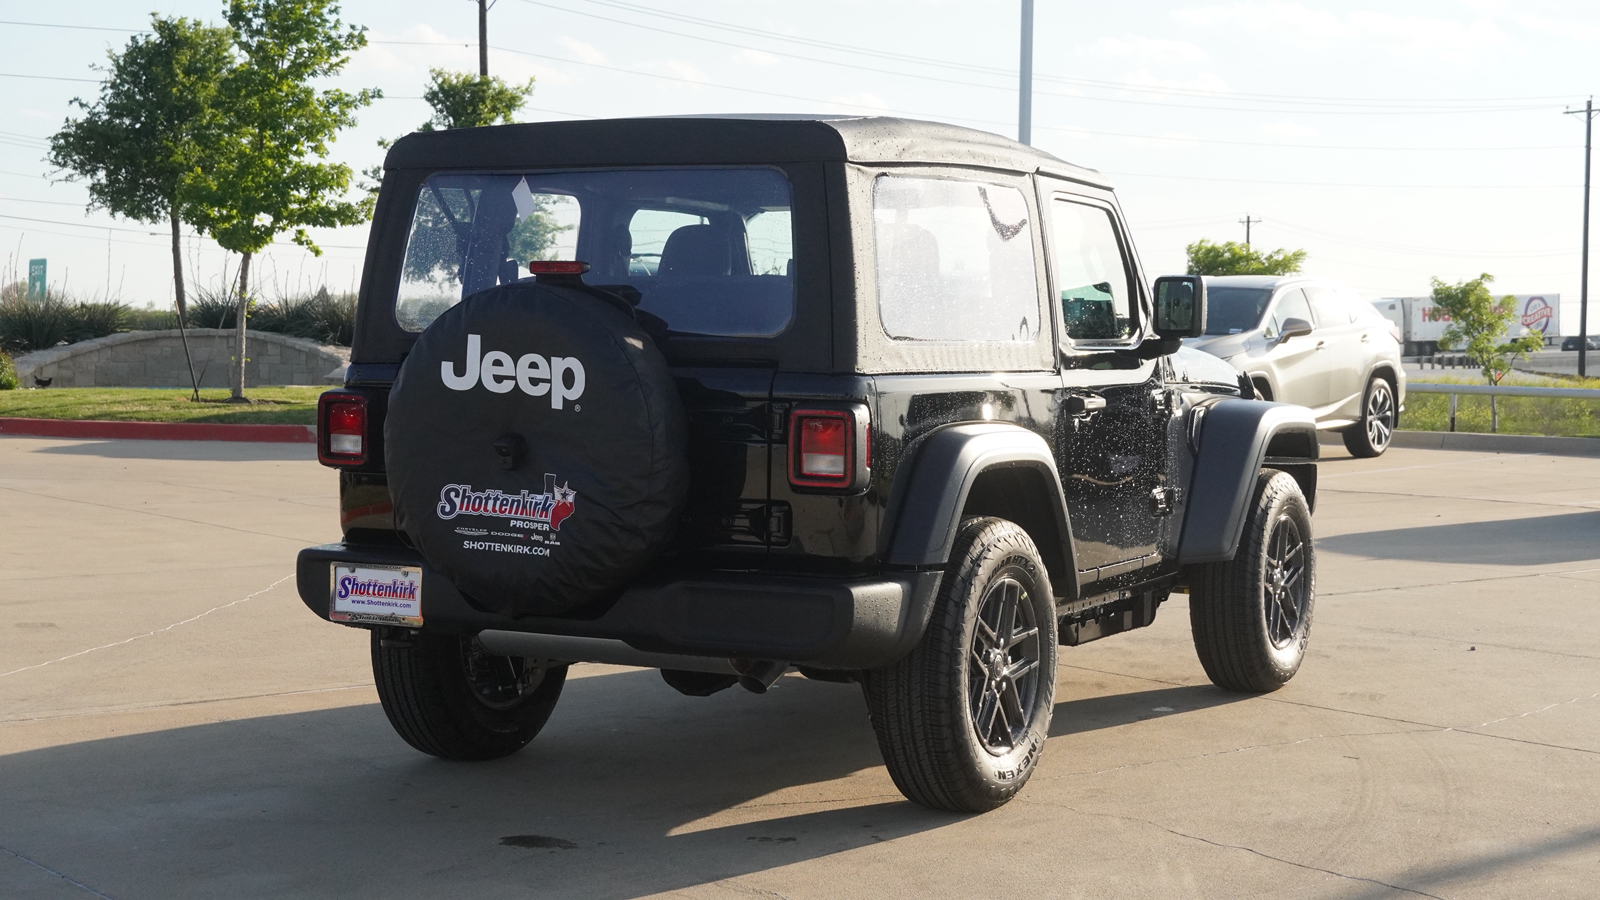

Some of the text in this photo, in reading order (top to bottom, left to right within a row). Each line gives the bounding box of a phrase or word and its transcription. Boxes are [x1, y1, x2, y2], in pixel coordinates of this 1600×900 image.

[31, 265, 44, 275] EXIT
[1522, 307, 1551, 325] CREATIVE
[441, 334, 586, 410] Jeep
[437, 484, 557, 521] Shottenkirk
[510, 520, 550, 531] PROSPER
[490, 531, 525, 539] DODGE
[531, 532, 544, 542] Jeep
[463, 540, 550, 557] SHOTTENKIRK.COM
[338, 576, 417, 600] Shottenkirk
[351, 600, 411, 608] www.Shottenkirk.com
[997, 742, 1037, 780] NEXEN
